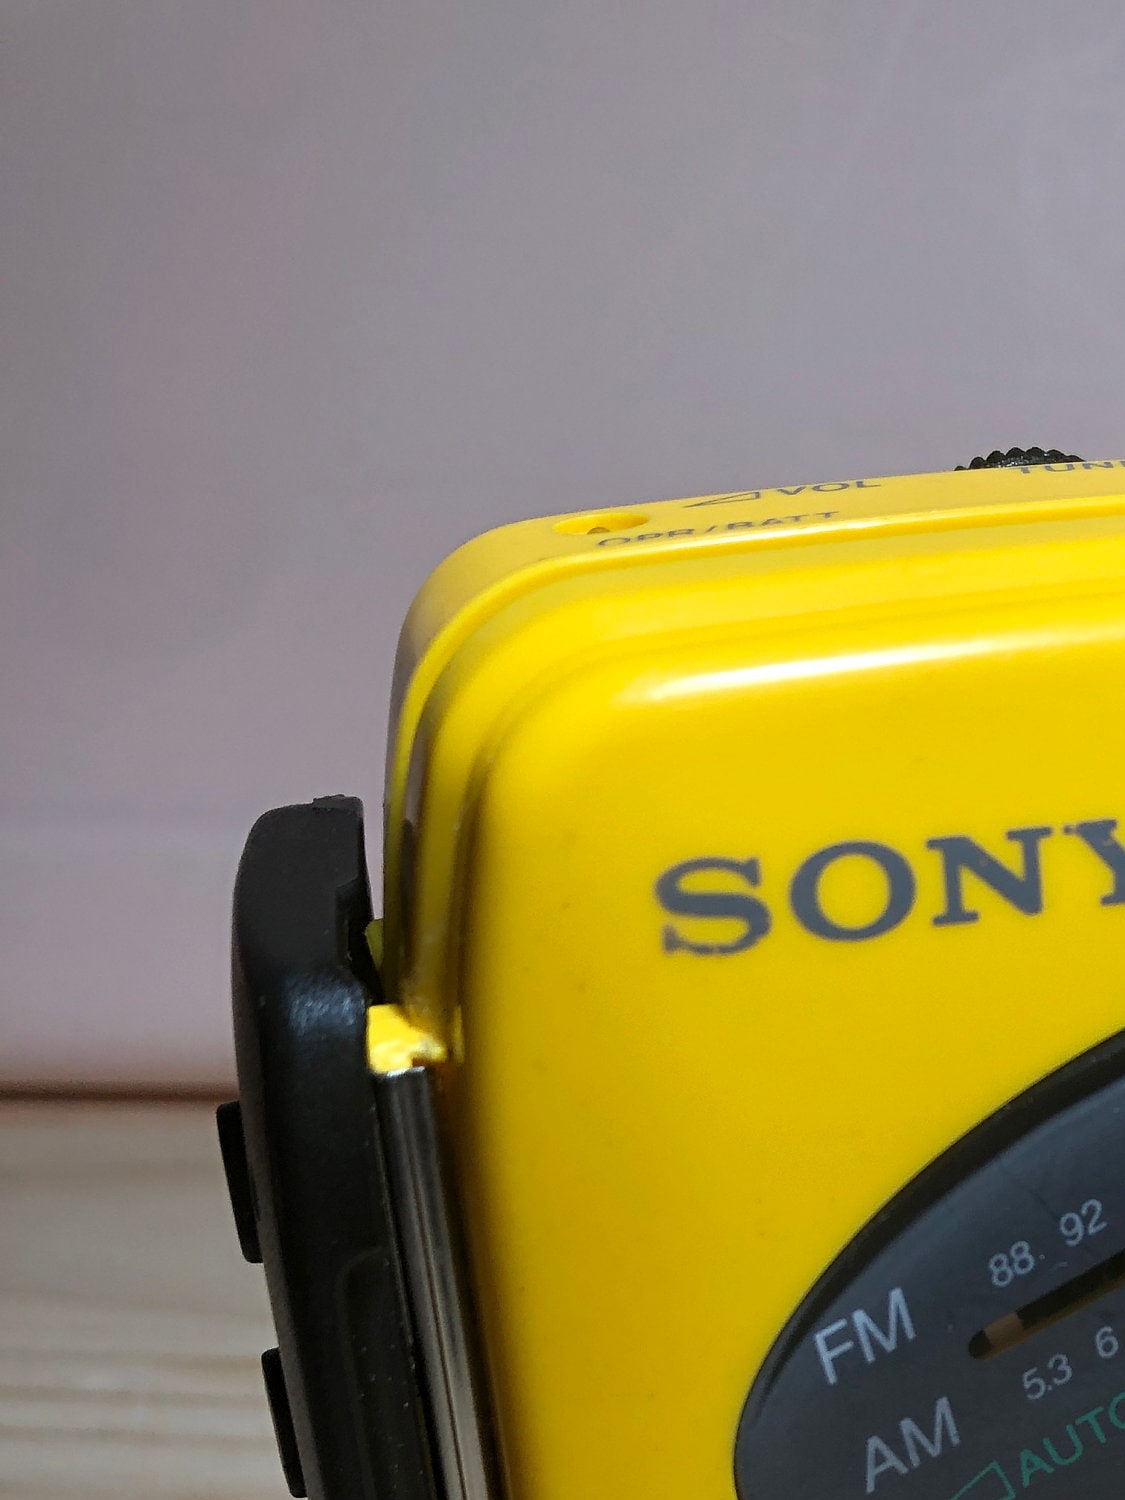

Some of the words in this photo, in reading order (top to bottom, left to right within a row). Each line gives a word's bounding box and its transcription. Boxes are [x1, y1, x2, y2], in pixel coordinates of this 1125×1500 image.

[597, 511, 839, 546] OPR/BATT
[776, 480, 881, 496] VOL
[814, 1287, 916, 1386] FM
[988, 1240, 1035, 1288] 88
[1059, 1199, 1107, 1246] 92
[865, 1396, 960, 1494] AM
[1022, 1353, 1073, 1401] 5.3
[1095, 1326, 1119, 1358] 6
